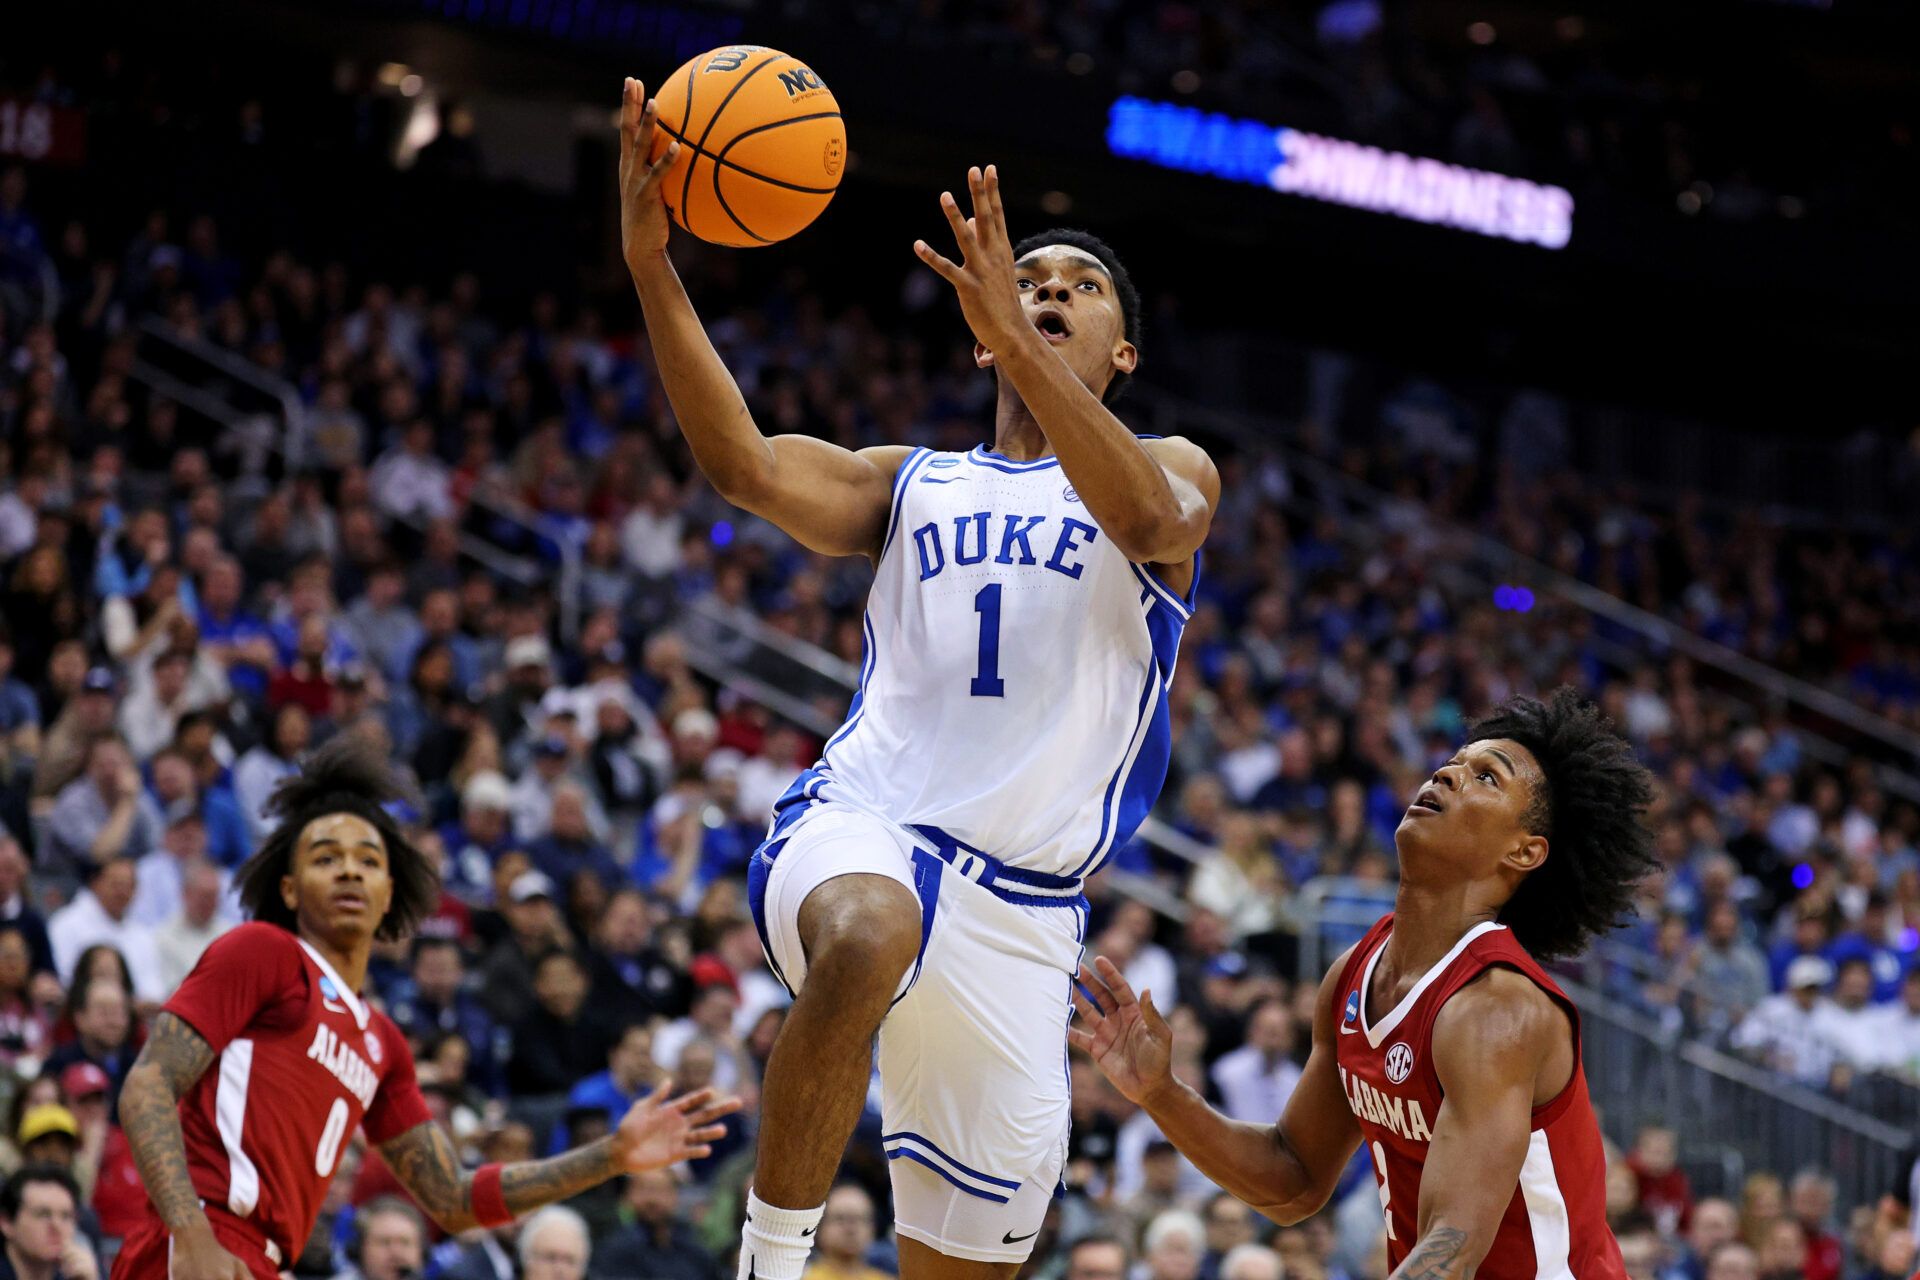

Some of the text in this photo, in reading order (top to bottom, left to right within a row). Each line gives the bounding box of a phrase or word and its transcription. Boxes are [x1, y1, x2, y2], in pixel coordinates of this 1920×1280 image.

[913, 512, 1098, 581] DUKE
[970, 583, 1004, 698] 1
[1337, 1062, 1432, 1141] LABAMA
[1386, 1044, 1411, 1082] SEC
[315, 1097, 349, 1177] 0
